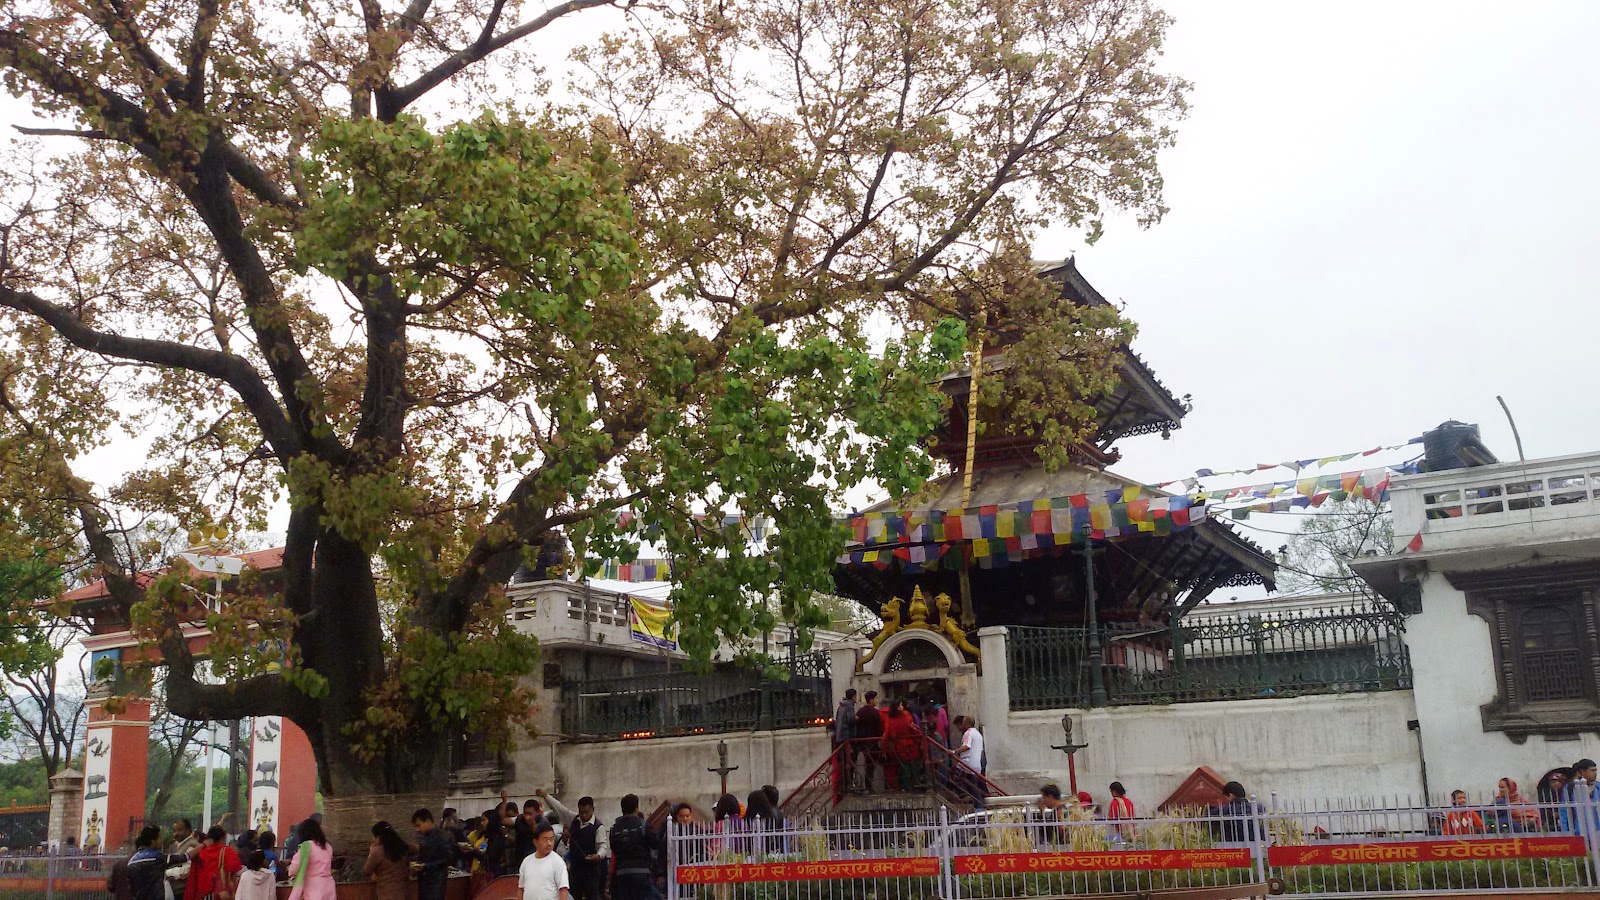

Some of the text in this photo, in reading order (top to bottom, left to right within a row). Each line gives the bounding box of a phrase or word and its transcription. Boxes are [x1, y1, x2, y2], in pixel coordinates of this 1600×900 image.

[1331, 843, 1419, 860] शालिमार
[1431, 838, 1523, 857] ज्वेलर्स
[964, 855, 987, 873] ॐ
[681, 866, 701, 883] ॐ
